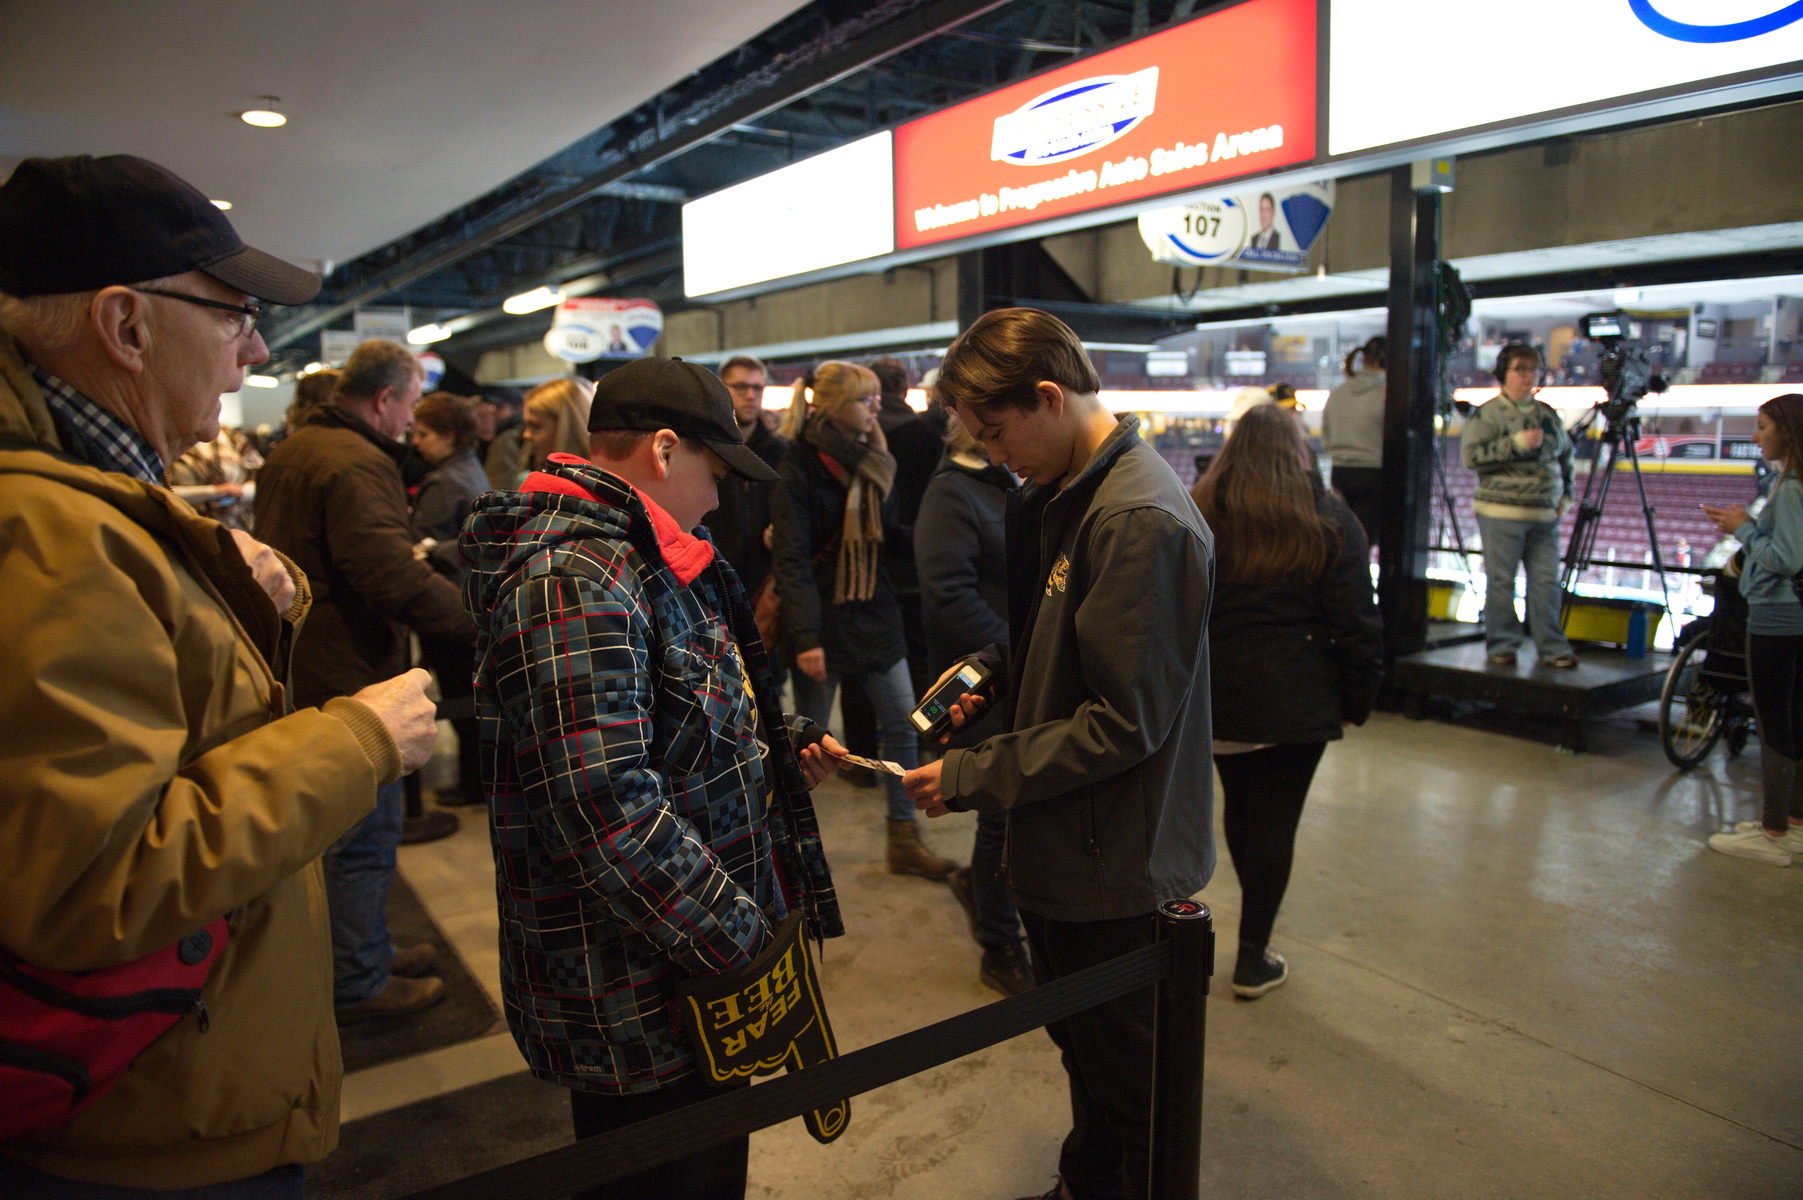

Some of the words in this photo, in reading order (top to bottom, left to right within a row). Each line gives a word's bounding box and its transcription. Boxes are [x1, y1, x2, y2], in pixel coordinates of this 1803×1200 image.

[914, 199, 980, 232] Welcome
[980, 193, 999, 217] to
[999, 168, 1098, 212] Progressive
[1098, 156, 1149, 188] Auto
[1149, 141, 1209, 176] Sales
[1210, 124, 1284, 163] Arena
[1183, 213, 1222, 238] 107
[706, 943, 797, 1030] BEE
[720, 978, 802, 1057] FEAR
